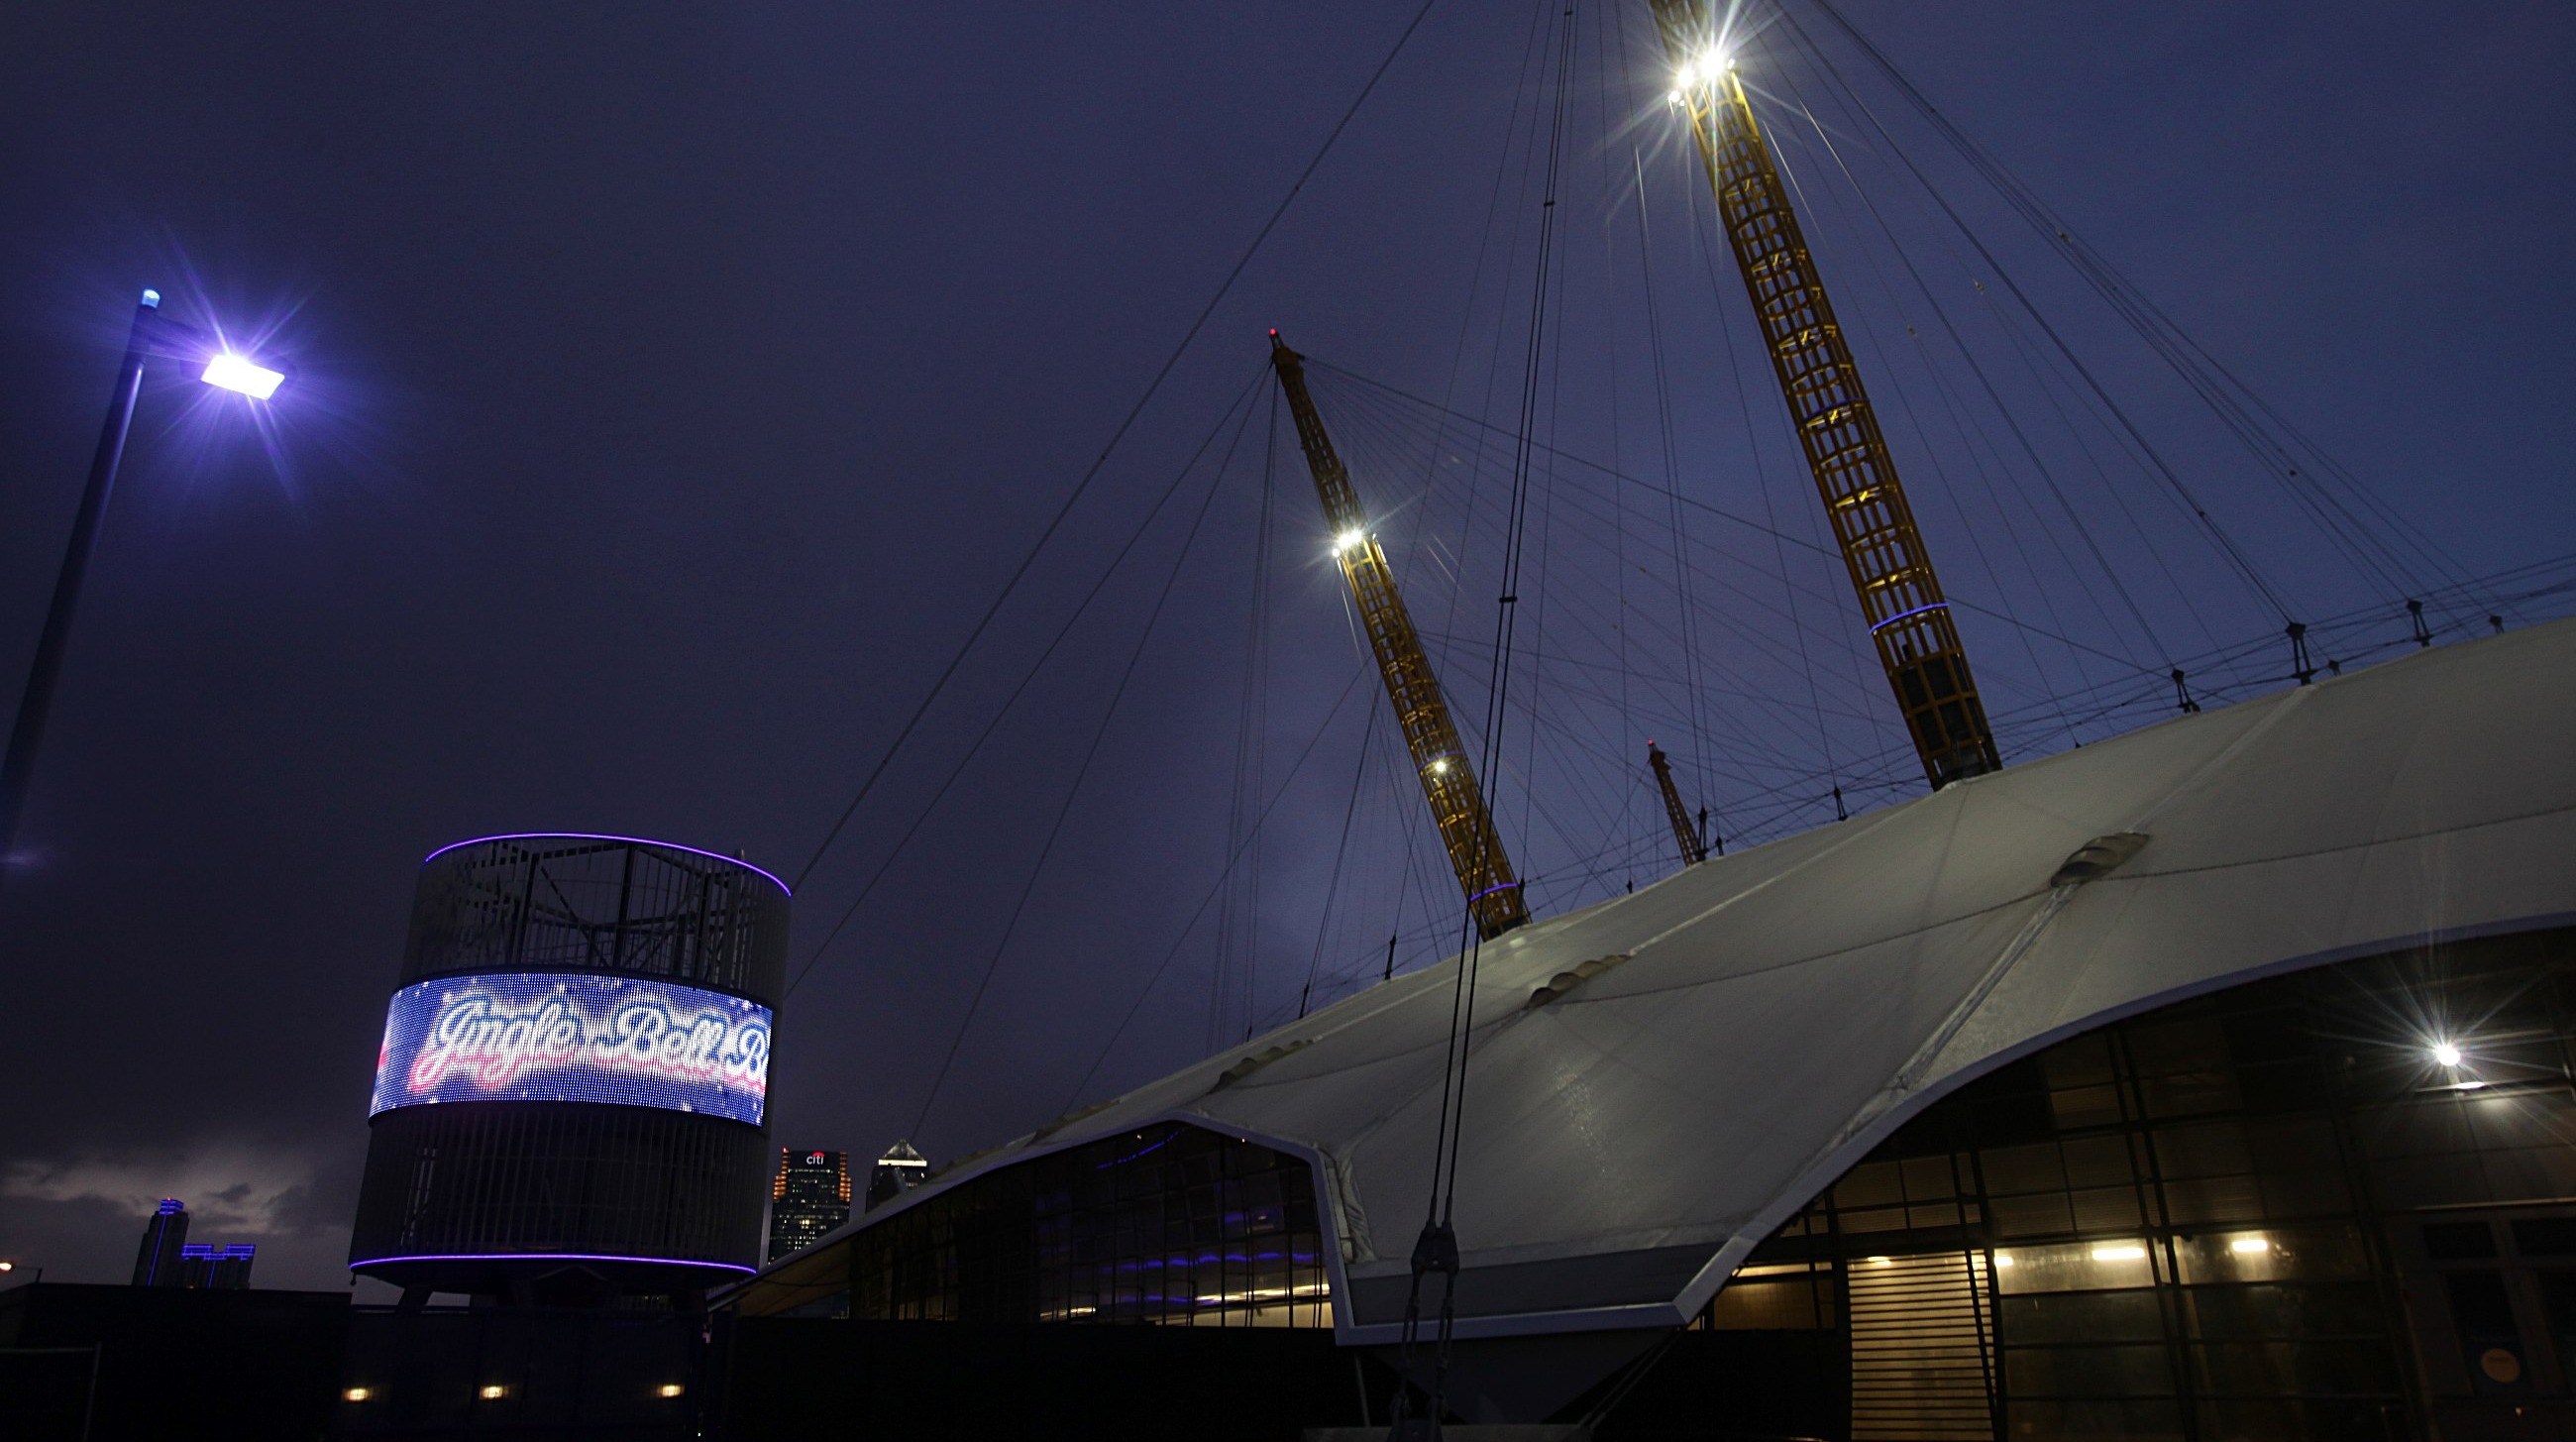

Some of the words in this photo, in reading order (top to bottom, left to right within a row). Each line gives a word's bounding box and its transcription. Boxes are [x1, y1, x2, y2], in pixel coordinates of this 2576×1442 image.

[412, 997, 585, 1088] Jingle
[596, 1006, 724, 1071] Bell
[726, 1027, 770, 1082] B
[805, 1154, 824, 1165] citi
